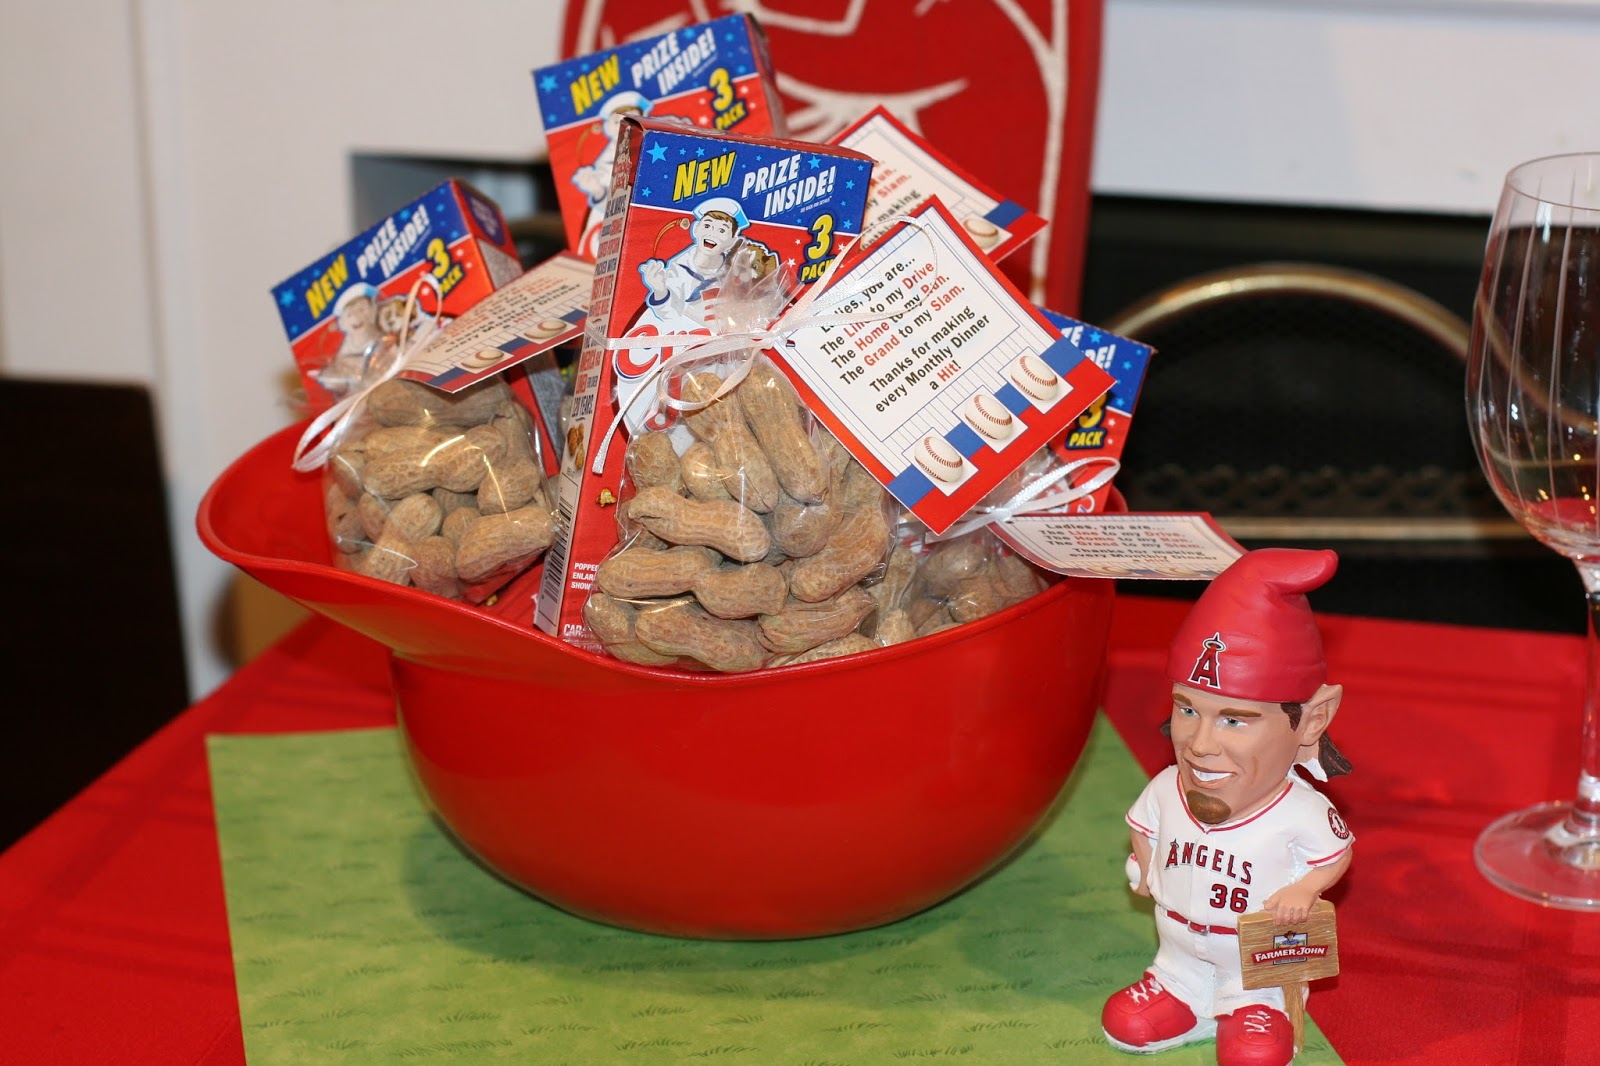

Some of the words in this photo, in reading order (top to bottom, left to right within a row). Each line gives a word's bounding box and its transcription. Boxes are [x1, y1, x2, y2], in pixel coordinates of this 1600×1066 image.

[569, 54, 621, 115] NEW
[630, 32, 681, 88] PRIZE
[657, 27, 716, 95] INSIDE!
[709, 67, 734, 111] 3
[715, 101, 746, 130] PACK
[672, 151, 738, 203] NEW
[741, 153, 802, 200] PRIZE
[763, 165, 837, 219] INSIDE!
[877, 189, 921, 222] making
[355, 217, 398, 279] PRIZE
[380, 203, 430, 278] INSIDE!
[426, 237, 450, 278] 3
[807, 213, 834, 260] 3
[305, 253, 348, 320] NEW
[861, 282, 885, 301] you
[884, 258, 916, 281] are...
[820, 336, 845, 355] The
[843, 318, 872, 338] Lin
[885, 287, 904, 305] my
[831, 349, 856, 369] The
[854, 322, 890, 351] Home
[839, 365, 865, 385] The
[863, 334, 901, 366] Grand
[898, 325, 914, 338] to
[913, 309, 933, 327] my
[930, 285, 966, 312] Slam.
[869, 357, 914, 392] Thanks
[911, 341, 929, 359] for
[930, 305, 976, 345] making
[875, 384, 909, 412] every
[904, 345, 955, 387] Monthly
[950, 314, 990, 349] Dinner
[929, 379, 940, 391] a
[936, 362, 962, 383] Hit!
[1068, 430, 1104, 447] PACK
[1188, 632, 1227, 689] A
[1164, 838, 1253, 885] ANGELS
[1209, 883, 1250, 914] 36
[1254, 948, 1296, 962] FARMER
[1296, 946, 1325, 956] JOHN
